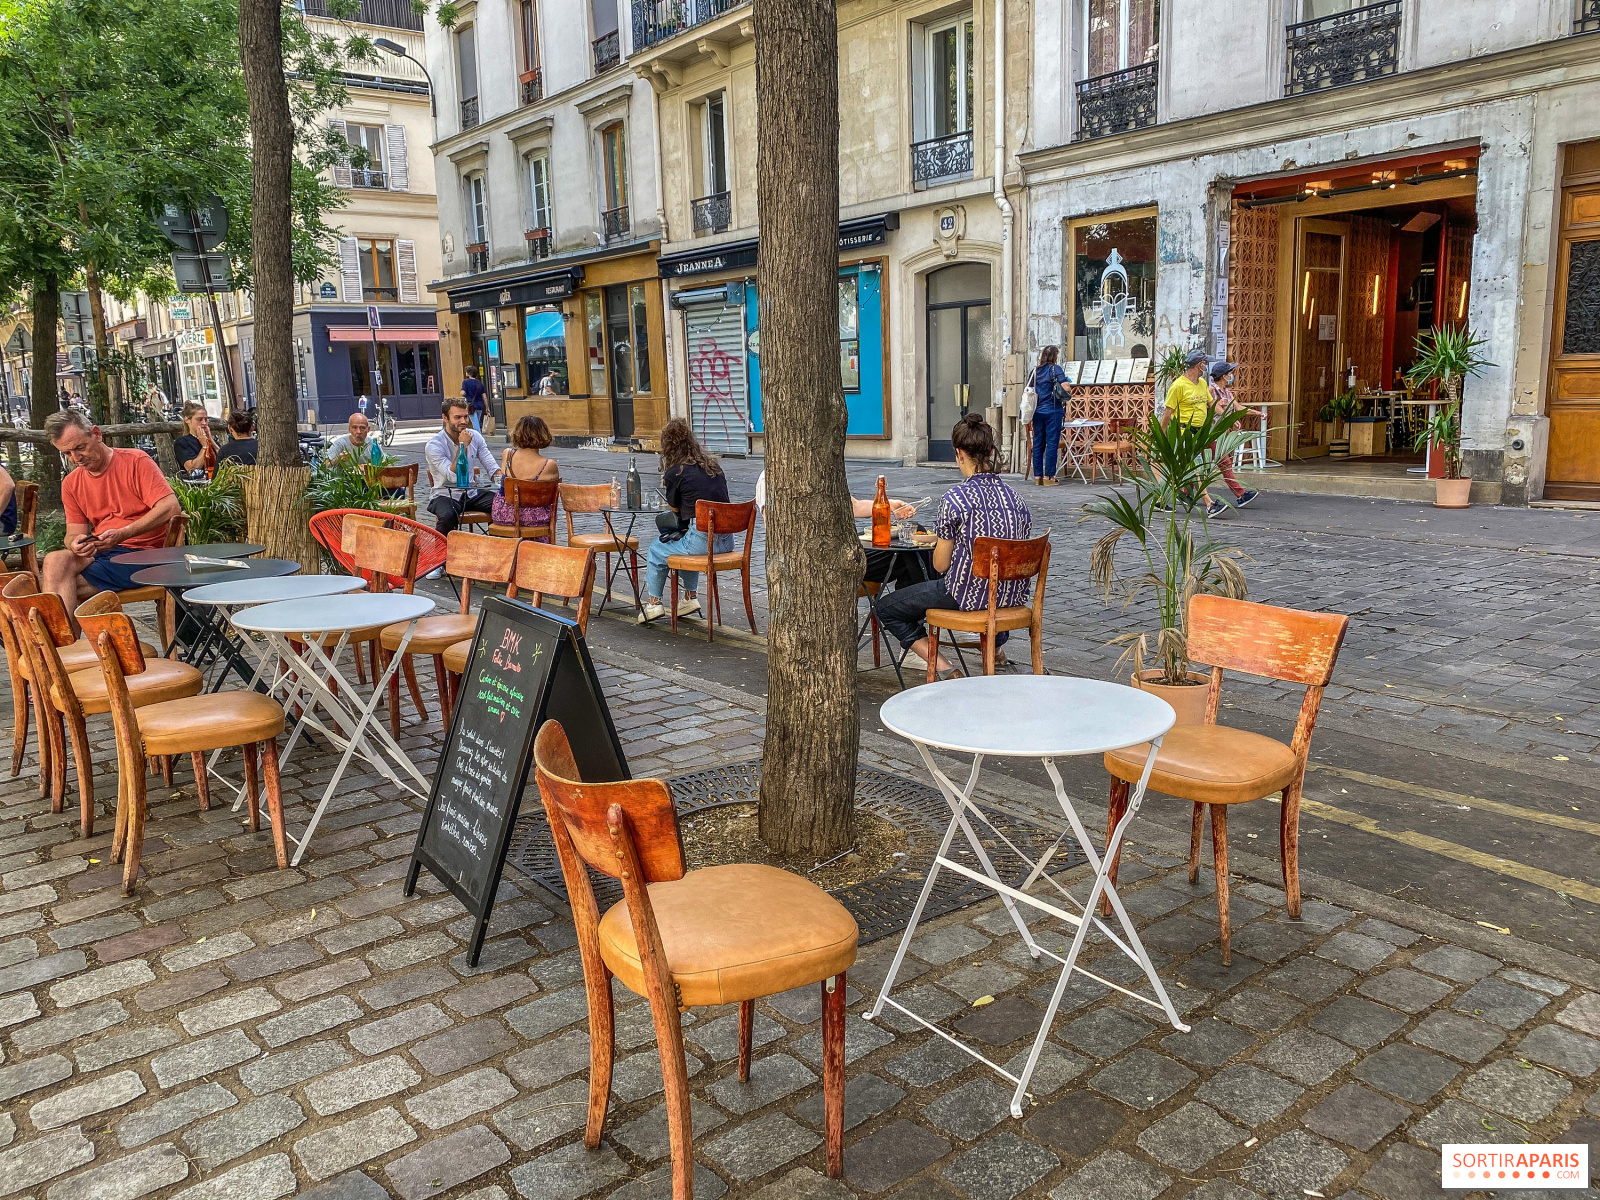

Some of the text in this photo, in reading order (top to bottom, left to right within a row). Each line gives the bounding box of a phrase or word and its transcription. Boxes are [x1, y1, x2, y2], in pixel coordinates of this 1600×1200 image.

[942, 217, 953, 229] 42
[839, 233, 873, 246] ÔTISSERIE
[177, 333, 205, 349] LAVERIE
[500, 628, 523, 655] BMK
